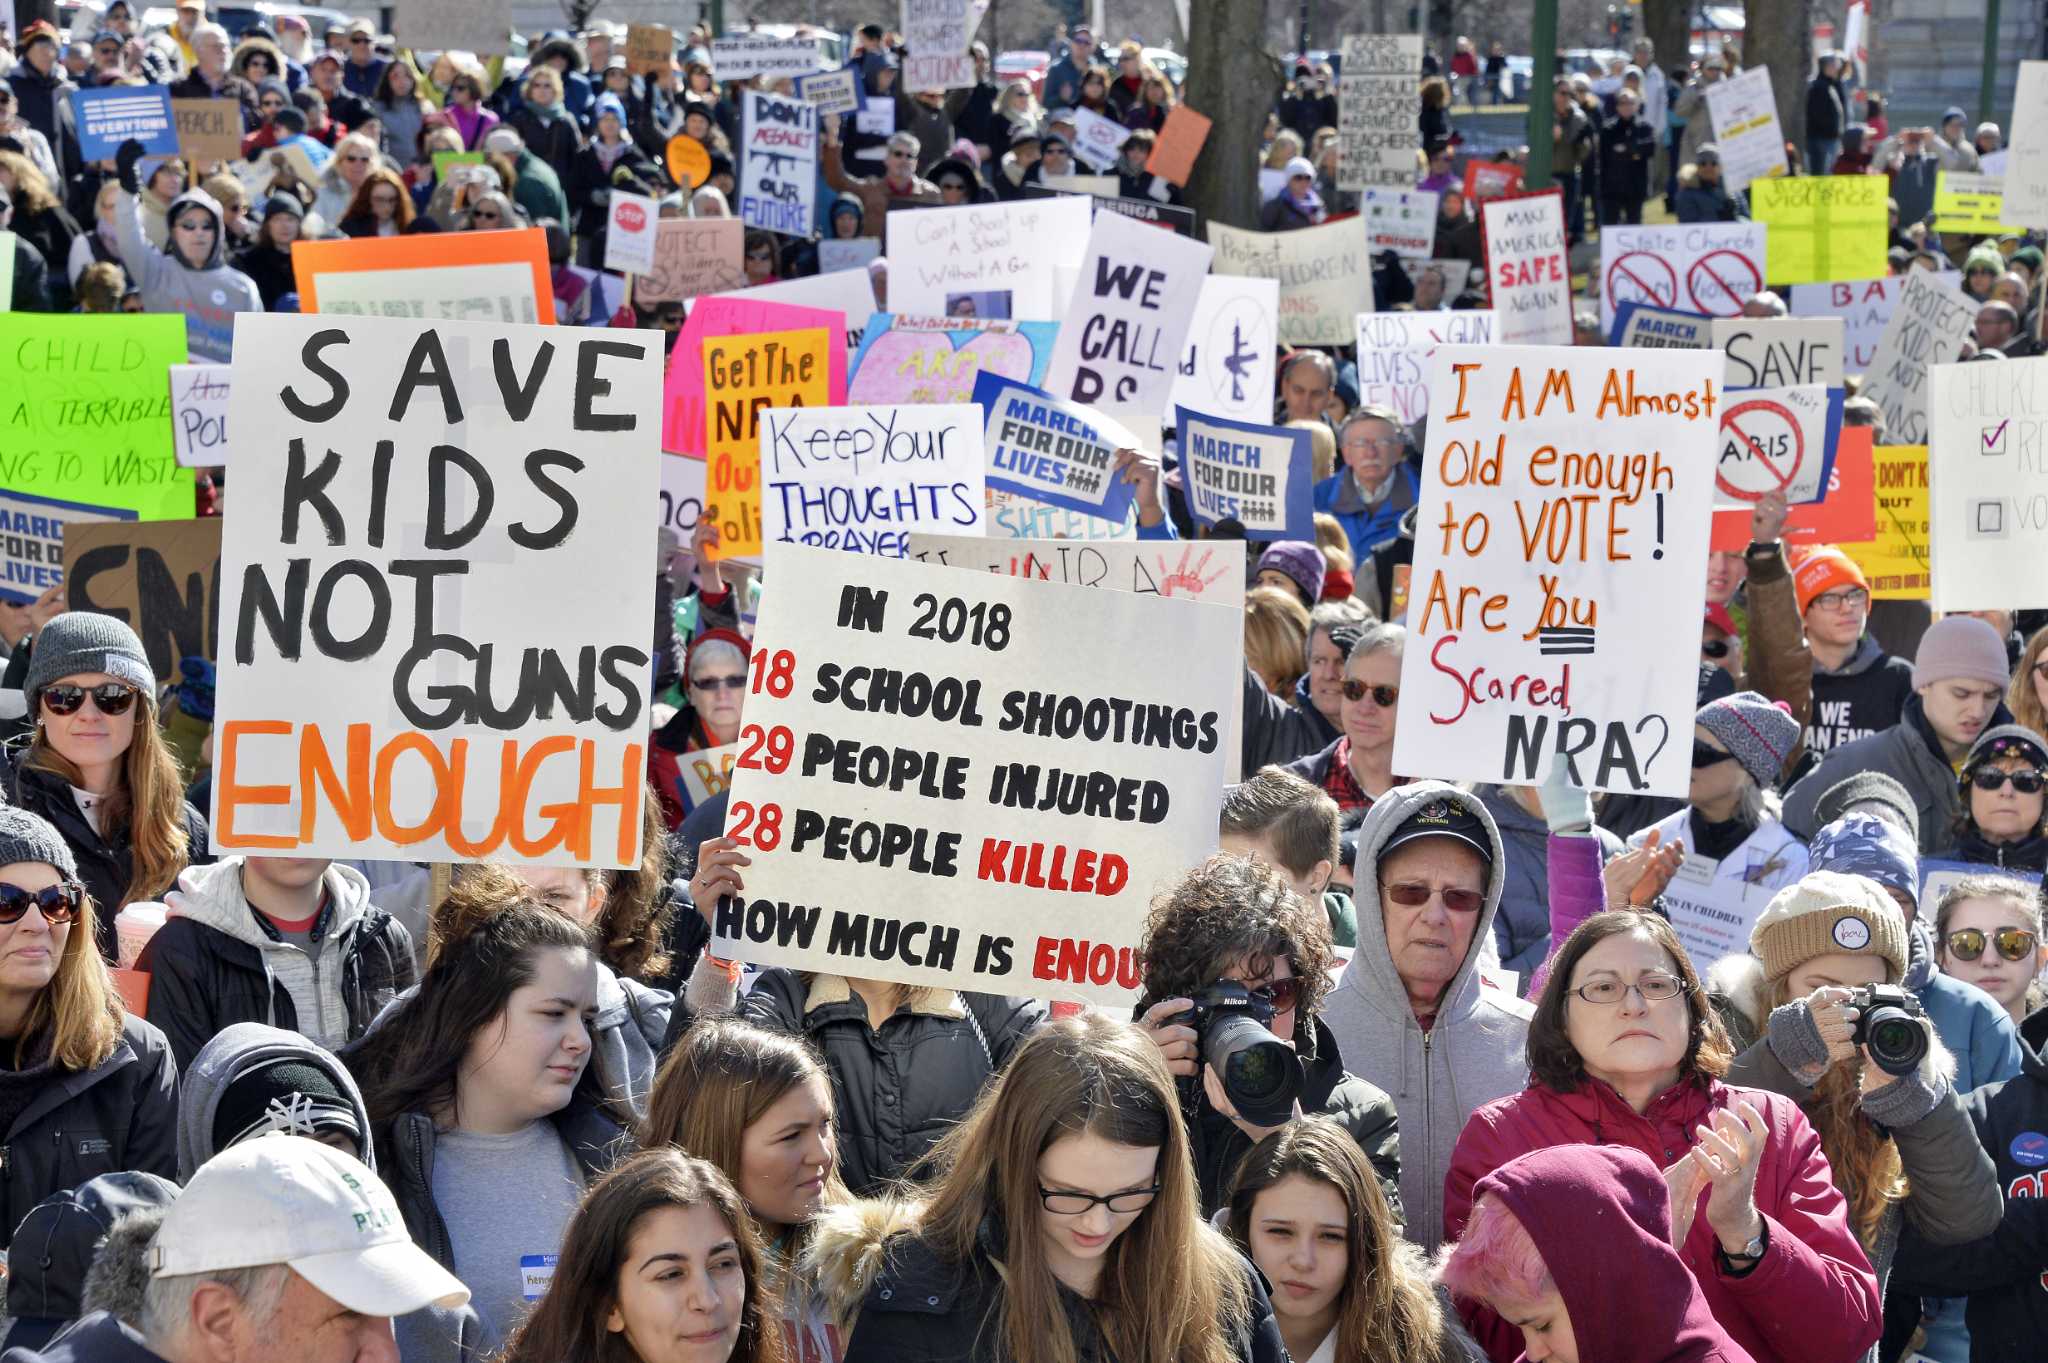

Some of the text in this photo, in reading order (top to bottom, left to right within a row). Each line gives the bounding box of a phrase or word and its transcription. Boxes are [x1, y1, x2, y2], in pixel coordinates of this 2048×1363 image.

[741, 196, 808, 233] FUTURE
[759, 177, 800, 203] OUR
[1495, 229, 1564, 255] AMERICA
[1094, 255, 1167, 311] WE
[1499, 254, 1563, 288] SAFE
[1511, 288, 1558, 312] AGAIN
[1080, 313, 1165, 372] CALL
[1636, 317, 1697, 338] MARCH
[17, 337, 146, 373] CHILD
[709, 342, 815, 391] Get The
[1725, 332, 1829, 388] SAVE
[1887, 360, 1928, 394] NOT
[280, 328, 646, 432] SAVE
[1446, 363, 1717, 423] I AM Almost
[11, 396, 171, 429] A TERRIBLE
[1004, 398, 1099, 442] MARCH
[770, 412, 875, 475] Keep
[866, 409, 957, 464] Your
[992, 445, 1069, 486] LIVES
[999, 420, 1110, 470] FOR OUR
[1192, 432, 1261, 470] MARCH
[55, 450, 83, 483] TO
[103, 449, 187, 487] WASTE
[1194, 460, 1276, 497] FOR OUR
[1440, 434, 1674, 506] Old enough
[1879, 461, 1917, 489] DON'T
[280, 438, 586, 551] KIDS
[769, 482, 977, 531] THOUGHTS
[1196, 491, 1240, 522] LIVES
[1880, 497, 1913, 508] BUT
[1439, 501, 1491, 557] to
[235, 558, 469, 666] NOT
[836, 584, 1013, 653] IN 2018
[1419, 569, 1509, 636] Are
[392, 634, 649, 731] GUNS
[750, 647, 1219, 754] 18 SCHOOL SHOOTINGS
[1820, 701, 1852, 727] WE
[736, 723, 1171, 825] 29 PEOPLE INJURED
[1503, 713, 1670, 792] NRA?
[216, 719, 642, 867] ENOUGH
[726, 800, 1129, 897] 28 PEOPLE KILLED
[715, 893, 823, 950] HOW
[826, 909, 960, 972] MUCH
[973, 933, 1015, 976] IS
[1693, 904, 1744, 926] CHILDREN
